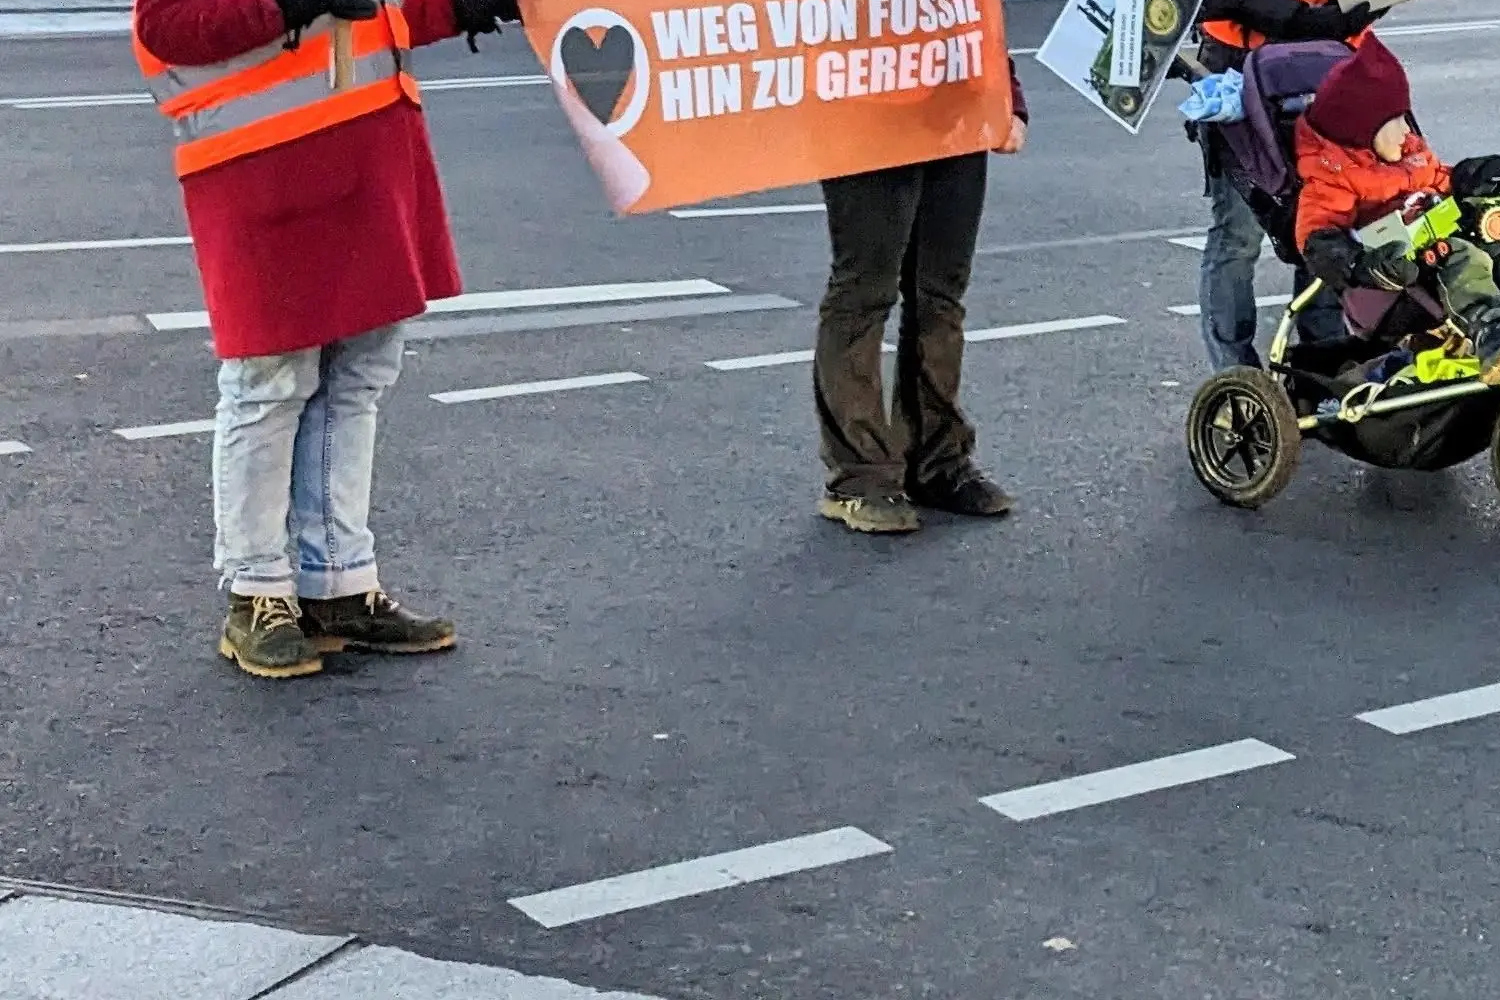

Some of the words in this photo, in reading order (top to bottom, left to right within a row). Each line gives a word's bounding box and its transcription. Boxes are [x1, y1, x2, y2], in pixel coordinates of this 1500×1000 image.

[650, 2, 759, 61] WEG
[658, 64, 743, 123] HIN
[750, 56, 804, 111] ZU
[816, 30, 985, 101] GERECHT
